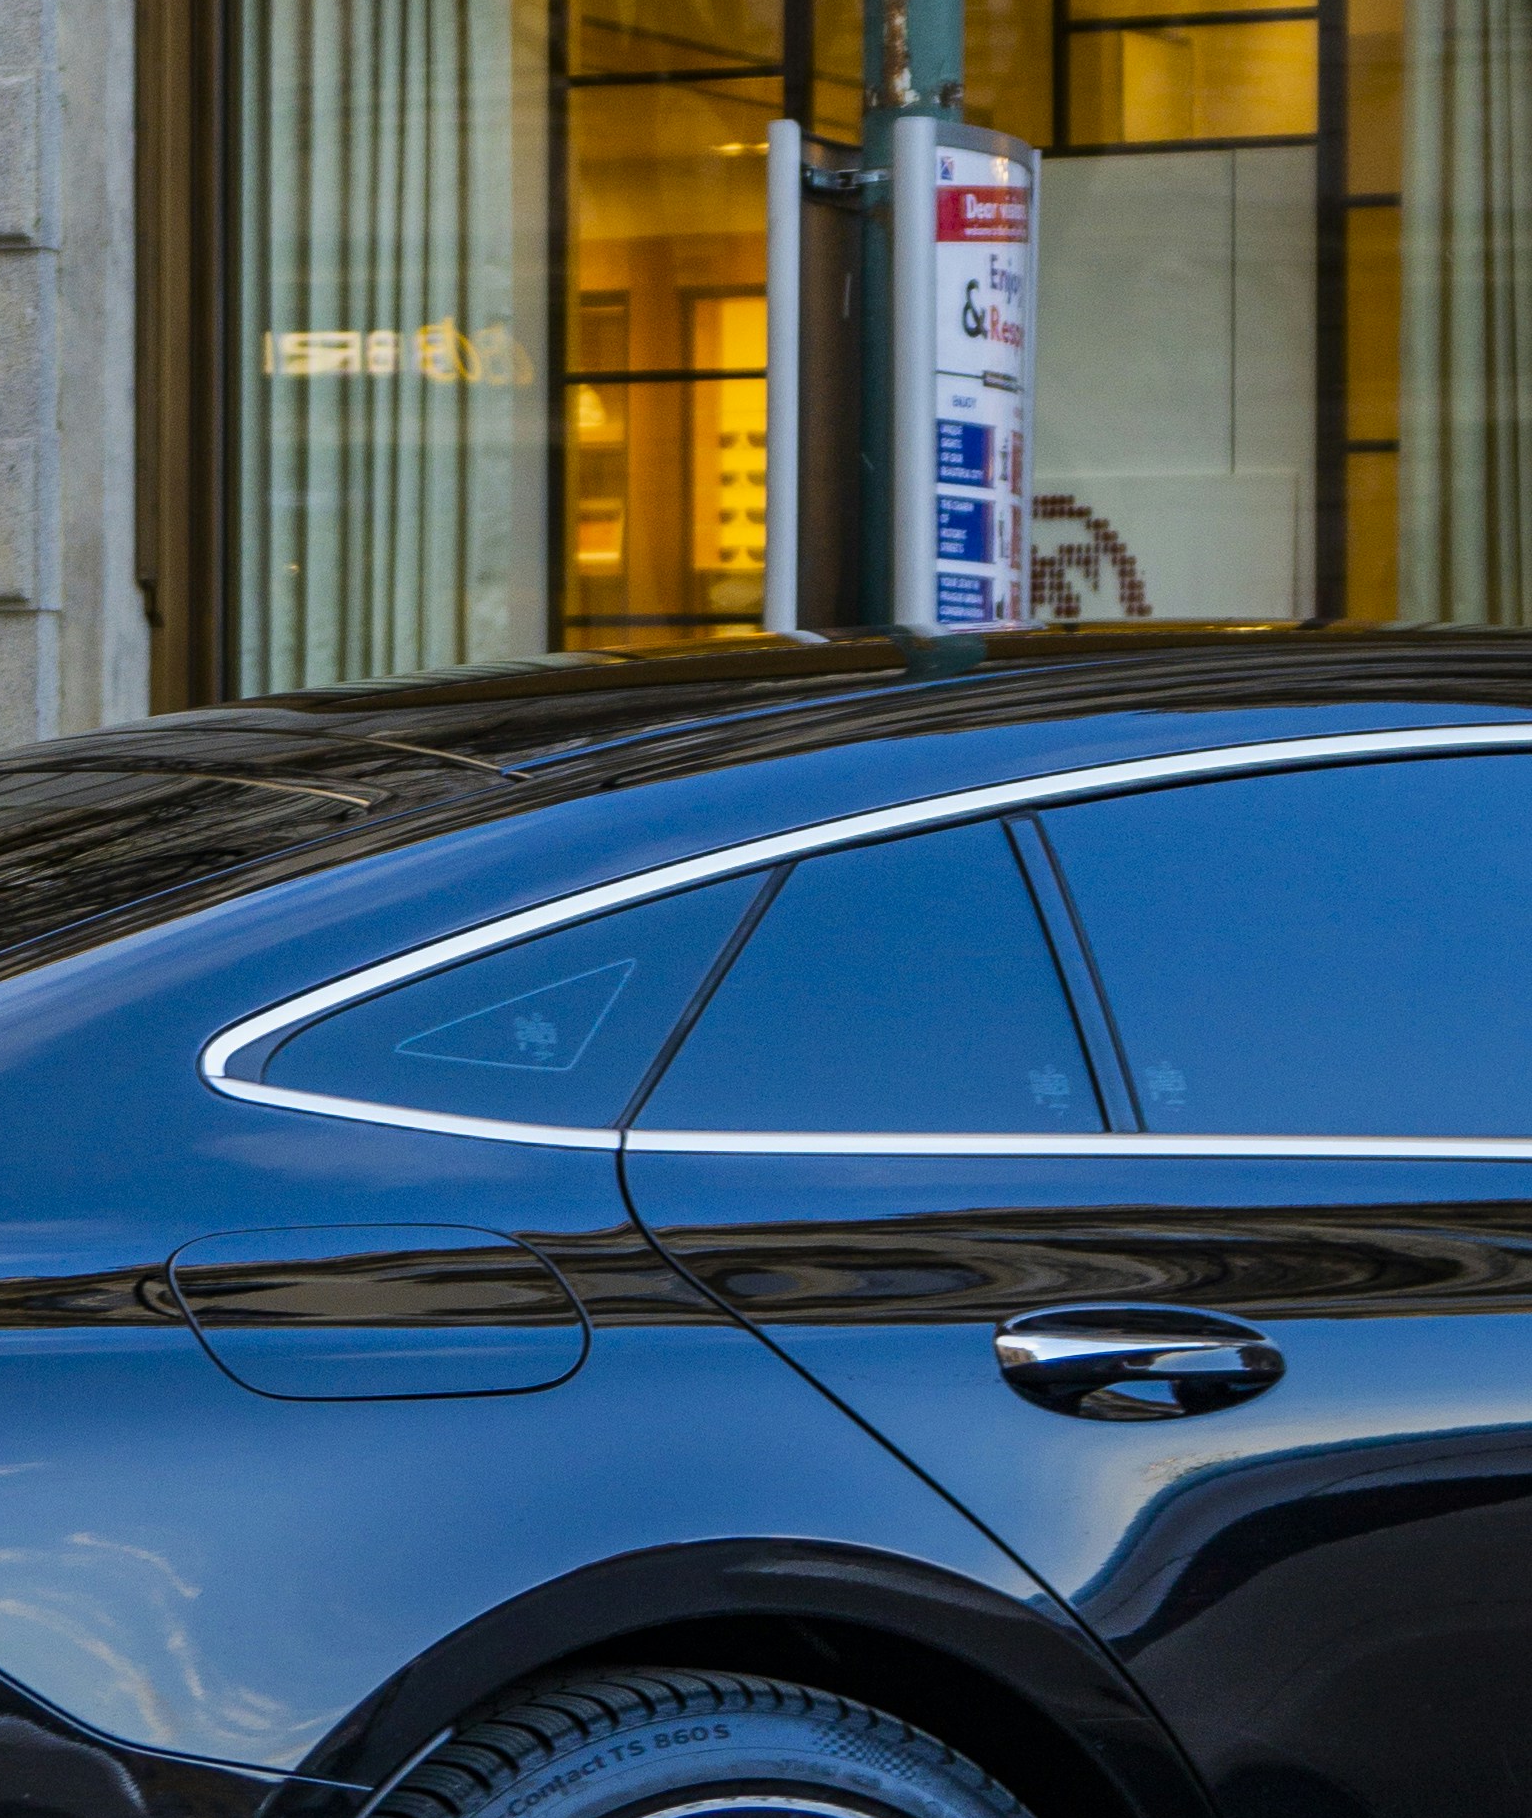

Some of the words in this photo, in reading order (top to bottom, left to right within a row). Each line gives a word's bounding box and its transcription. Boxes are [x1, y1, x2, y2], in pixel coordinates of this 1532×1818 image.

[964, 193, 996, 220] Dear
[962, 278, 988, 339] &
[608, 1739, 646, 1762] TS
